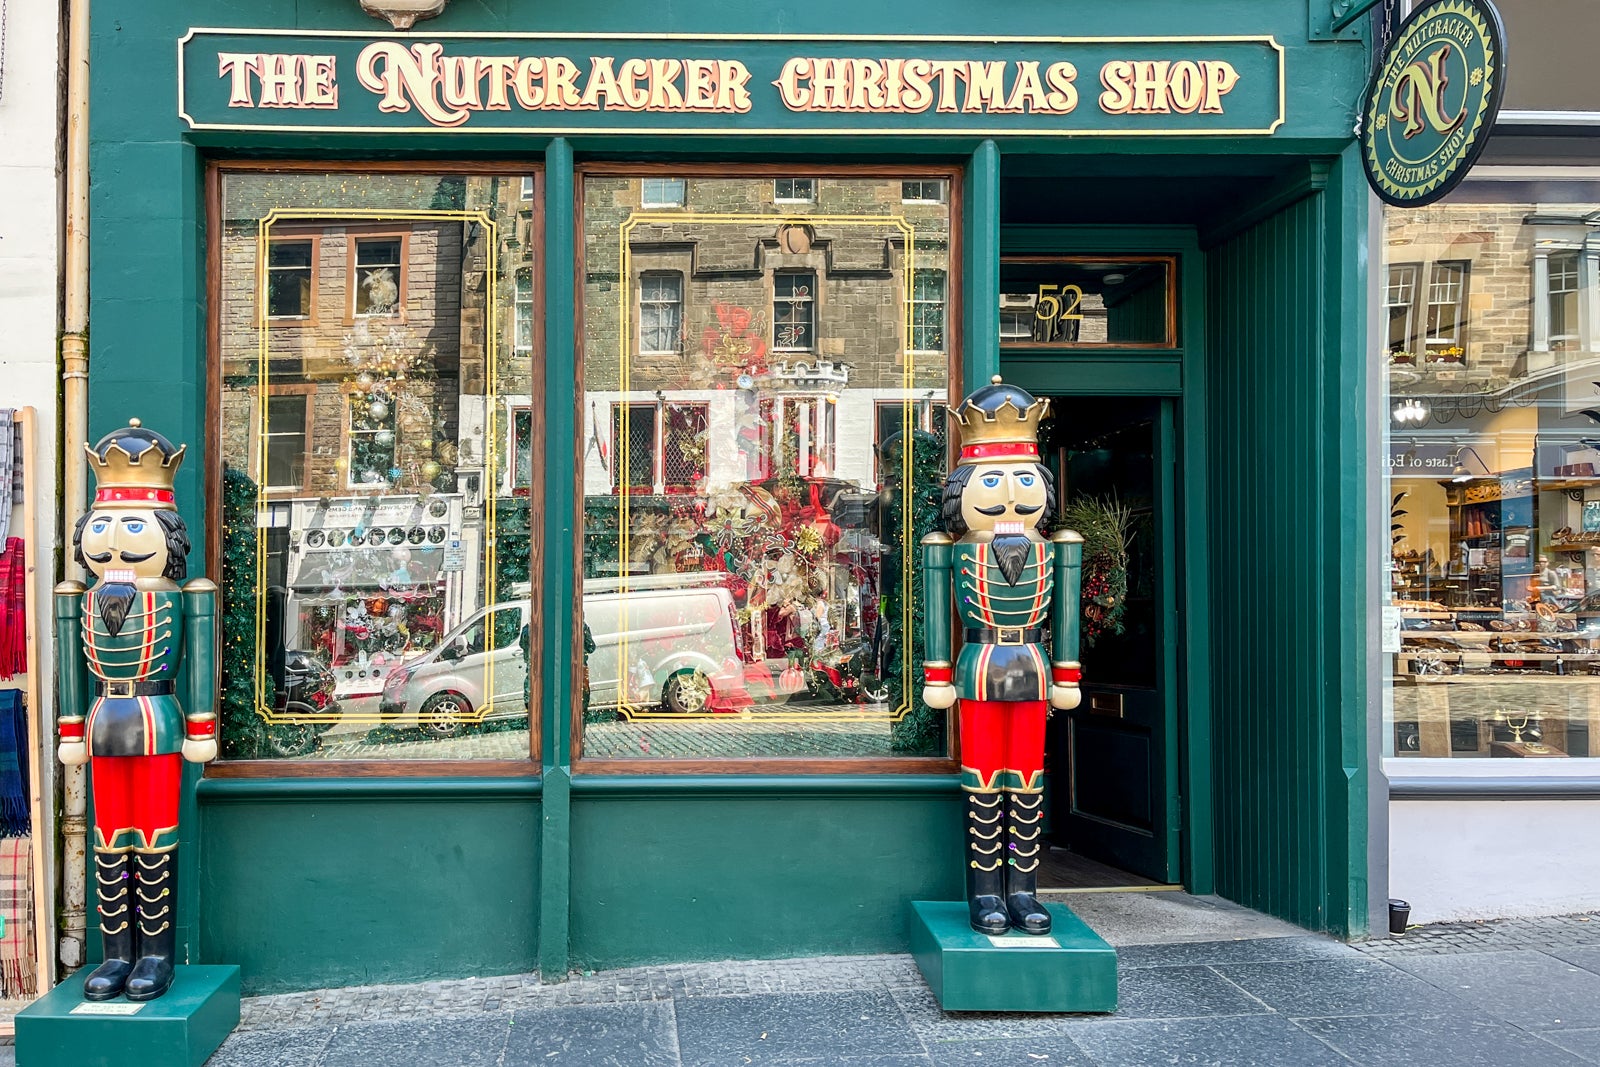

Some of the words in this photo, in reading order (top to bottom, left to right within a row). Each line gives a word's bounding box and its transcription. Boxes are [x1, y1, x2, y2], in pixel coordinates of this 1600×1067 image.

[217, 52, 338, 109] THE
[356, 41, 752, 127] NUTCRACKER
[771, 57, 1079, 114] CHRISTMAS
[1098, 60, 1240, 114] SHOP
[1384, 55, 1406, 88] THE
[1405, 18, 1474, 49] NUTCRACKER
[1385, 158, 1438, 183] CHRISTMAS
[1441, 126, 1467, 166] SHOP
[1036, 284, 1084, 320] 52
